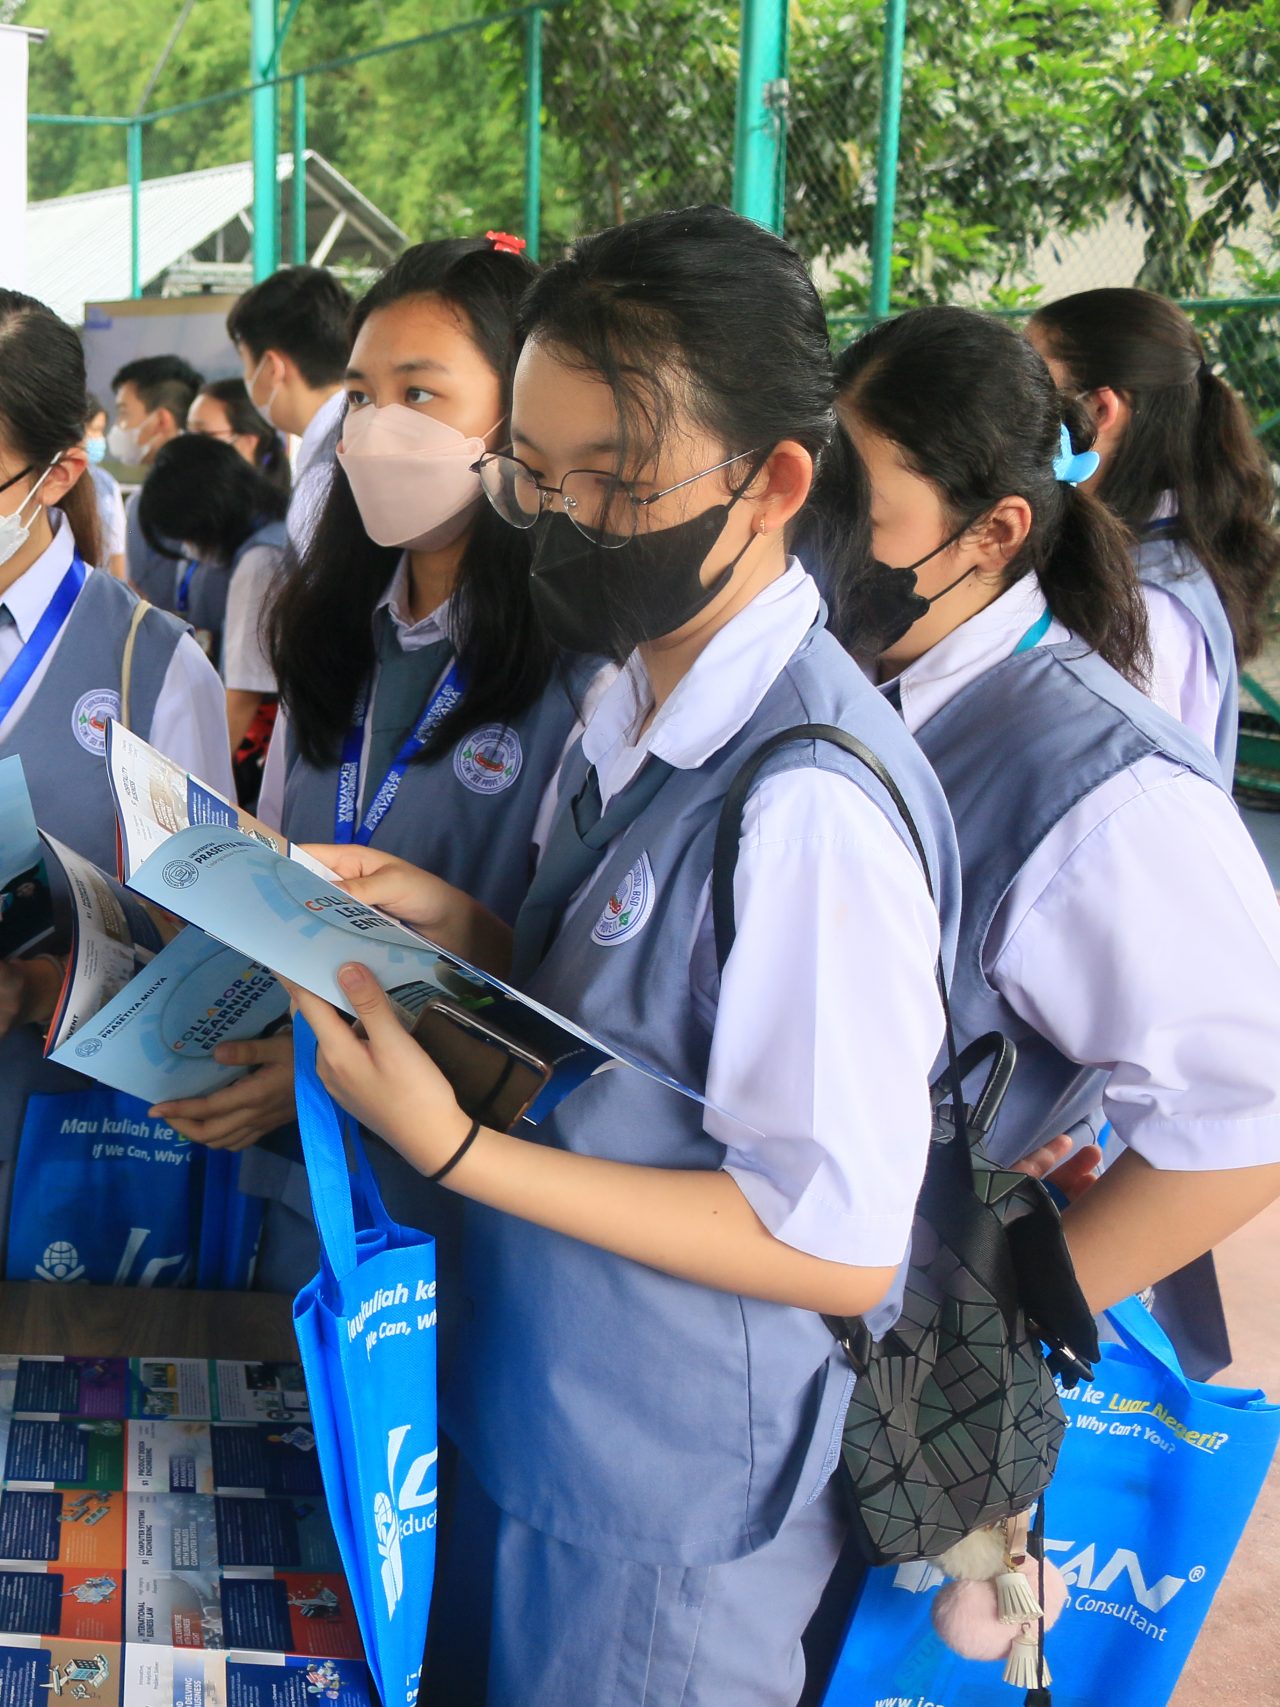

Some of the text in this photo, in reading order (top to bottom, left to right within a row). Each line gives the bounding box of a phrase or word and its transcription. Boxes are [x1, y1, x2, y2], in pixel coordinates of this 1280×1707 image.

[338, 763, 351, 822] EKAYANA
[368, 777, 402, 831] EKAYANA
[194, 841, 237, 865] PRASETIYA
[101, 976, 168, 1039] PRASETIYA MULYA
[194, 975, 263, 1043] LEARNING
[61, 1117, 174, 1141] Mau kuliah ke
[92, 1144, 184, 1165] If We Can, Why
[415, 1280, 437, 1301] ke
[379, 1321, 412, 1339] Can,
[1082, 1384, 1230, 1450] ke Luar Negeri?
[1076, 1415, 1108, 1435] Why
[1143, 1427, 1177, 1454] You?
[145, 1448, 153, 1477] ENGINEERING
[145, 1525, 153, 1556] ENGINEERING
[190, 1543, 198, 1567] COMPUTER
[182, 1552, 190, 1566] WITH
[146, 1607, 154, 1638] BUSINESS LAW
[1074, 1594, 1169, 1642] Consultant
[184, 1677, 193, 1705] DELVING
